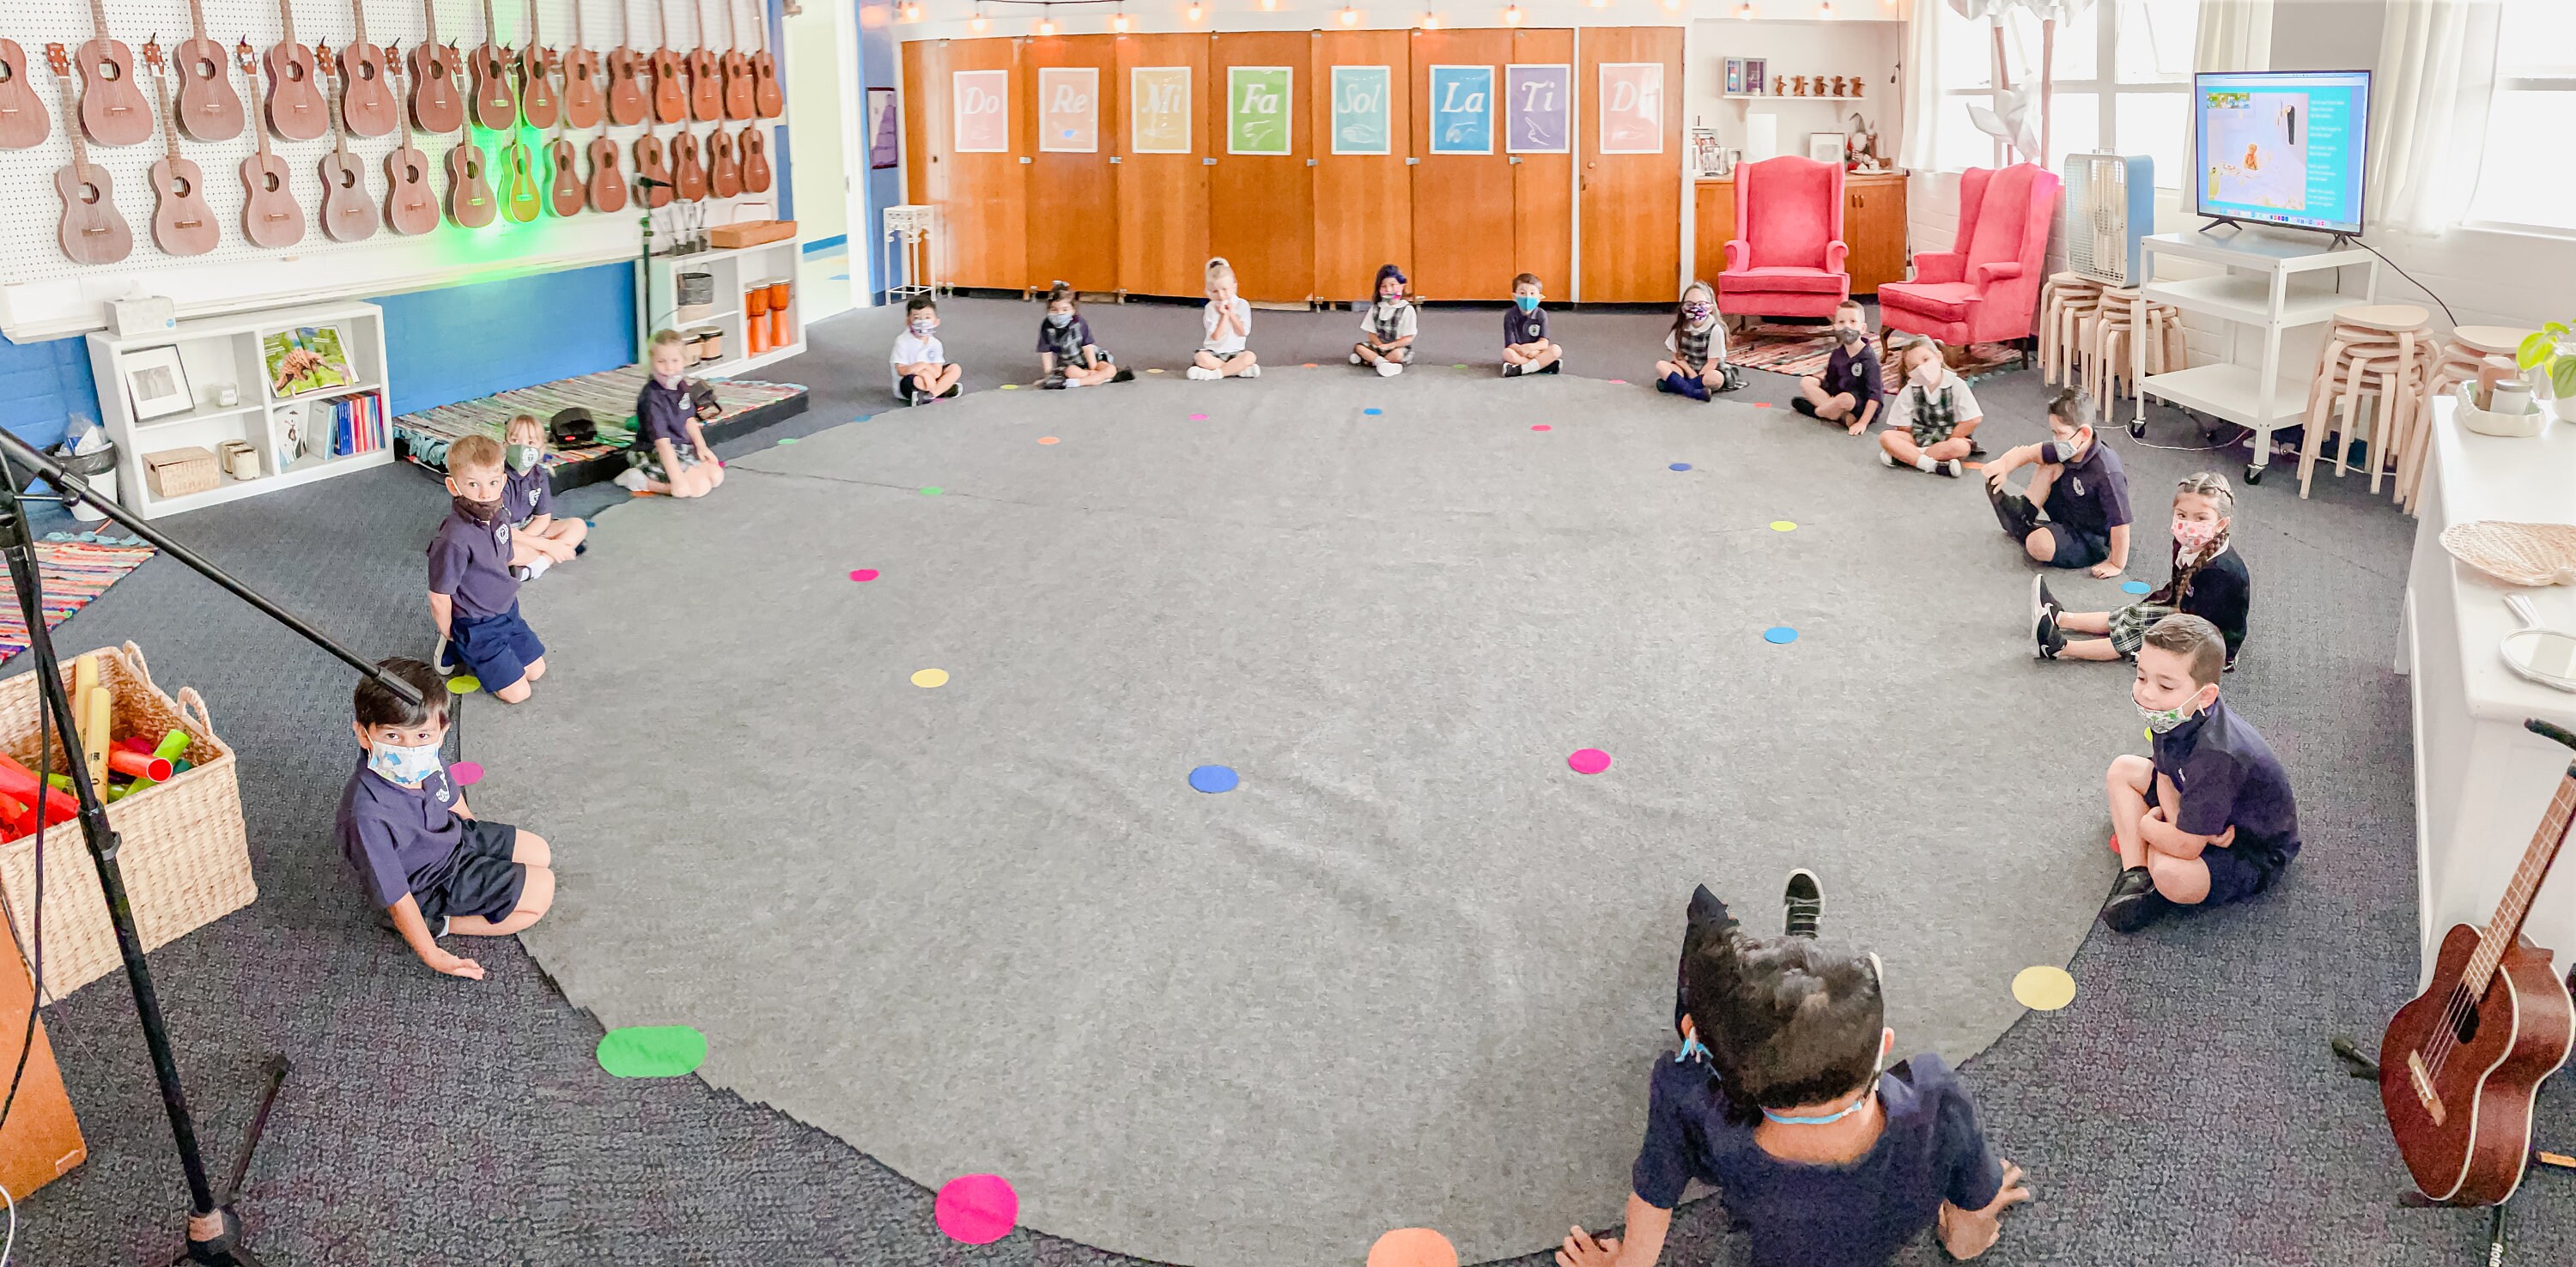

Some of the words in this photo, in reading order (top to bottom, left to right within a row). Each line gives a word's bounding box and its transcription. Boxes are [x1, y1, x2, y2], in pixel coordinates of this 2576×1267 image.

[963, 87, 999, 114] Do
[1051, 84, 1087, 114] Re
[1142, 84, 1182, 114] Mi
[1241, 83, 1279, 114] Fa
[1338, 84, 1381, 114] Sol
[1440, 82, 1485, 112] La
[1522, 81, 1555, 112] Ti
